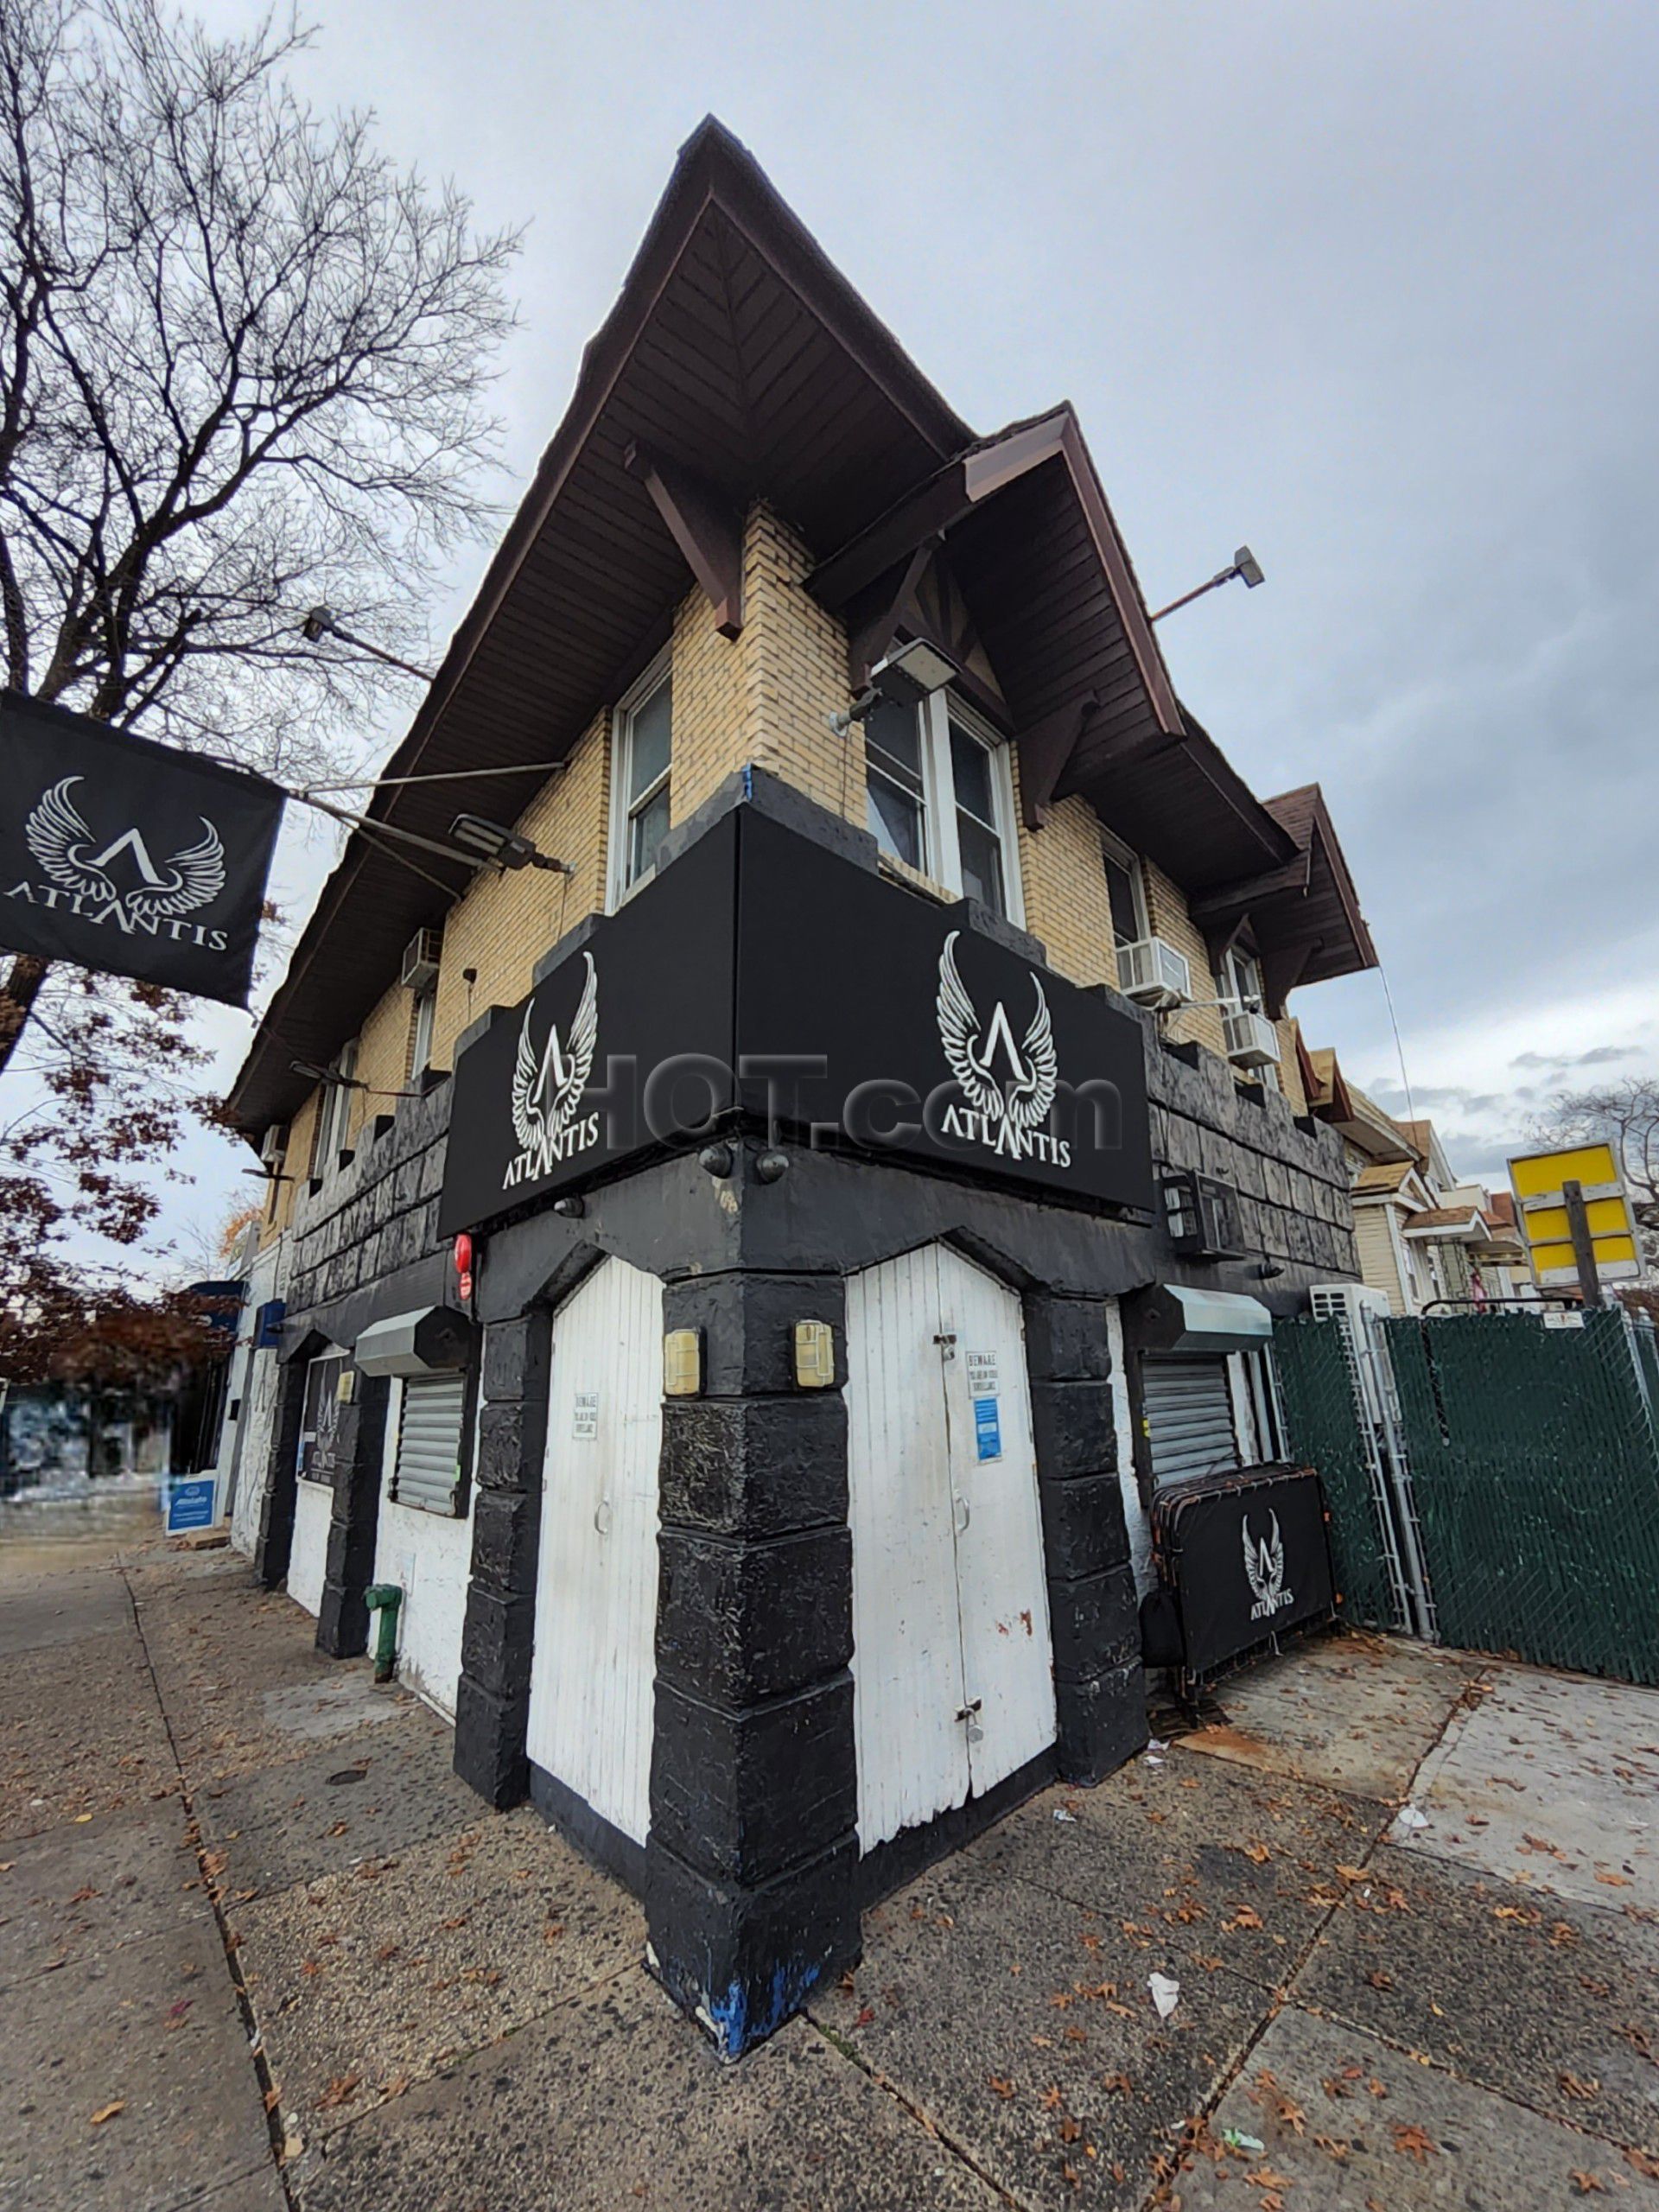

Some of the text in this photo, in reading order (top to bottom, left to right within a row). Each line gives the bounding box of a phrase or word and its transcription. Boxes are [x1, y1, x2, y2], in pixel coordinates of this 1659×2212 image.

[3, 880, 229, 951] ATLANTIS
[502, 1111, 600, 1190] ATLANTIS
[940, 1103, 1072, 1168] ATLANTIS
[1250, 1587, 1294, 1621] ATLANTIS
